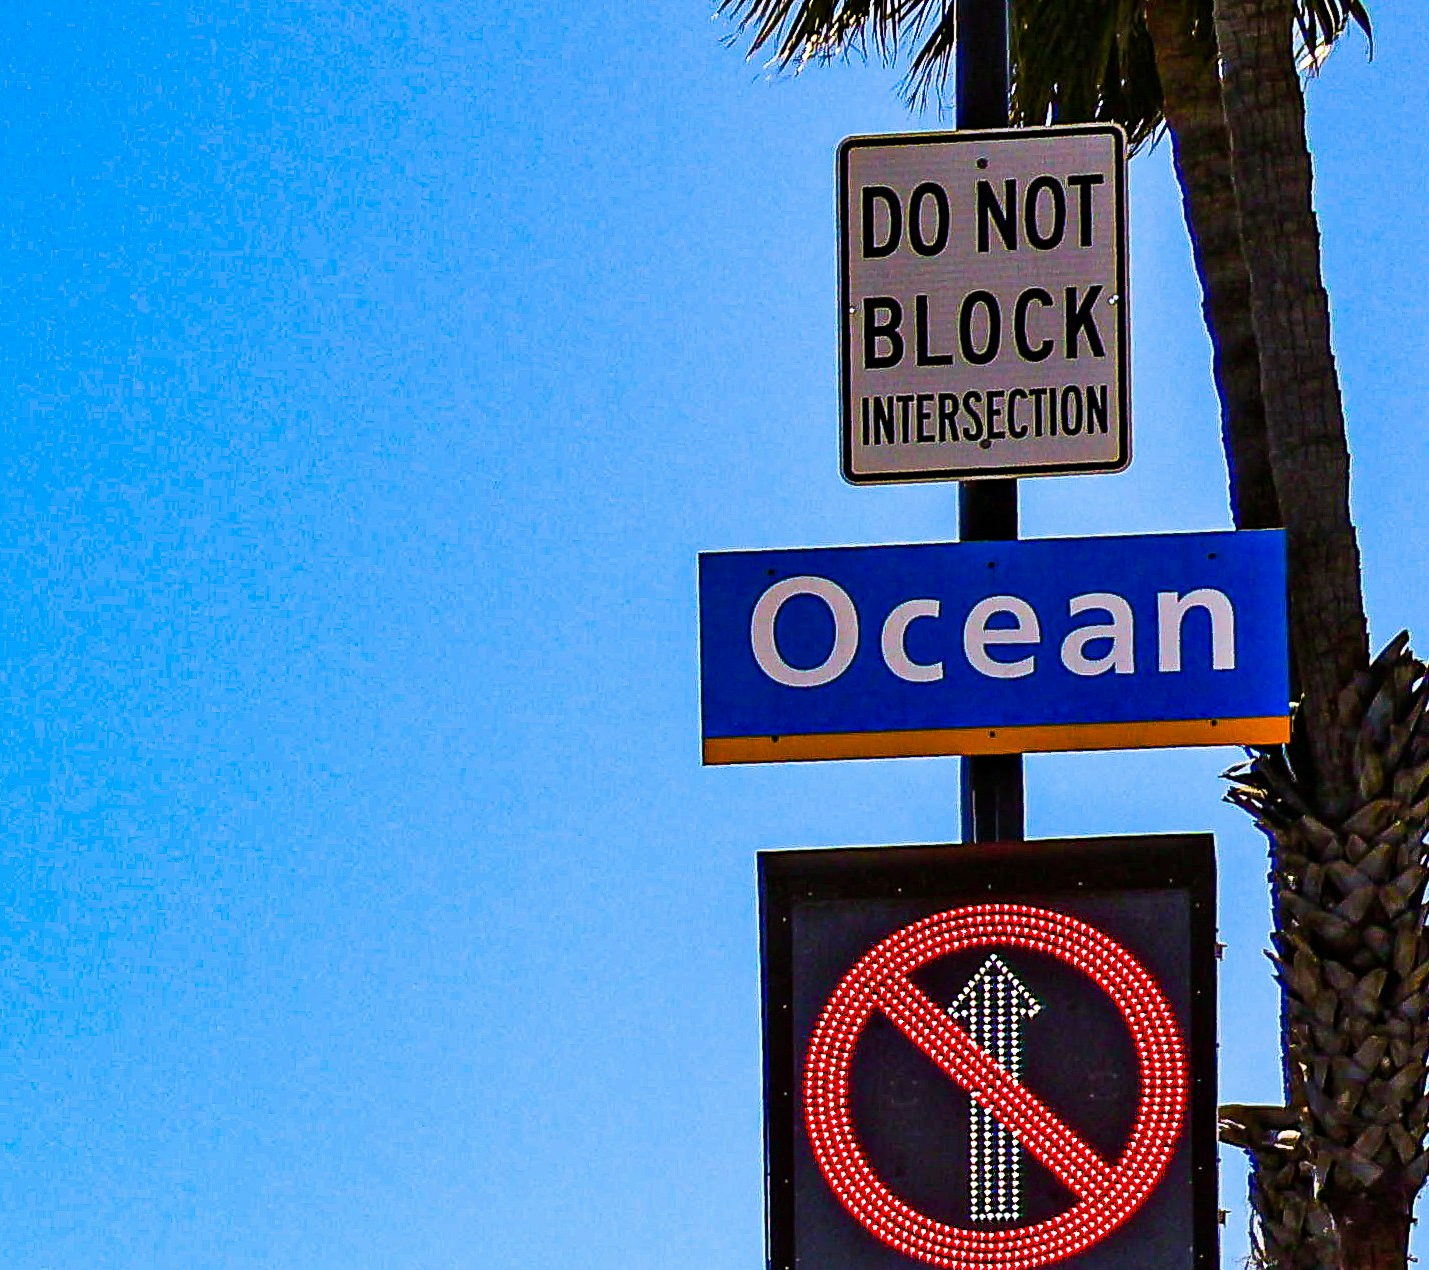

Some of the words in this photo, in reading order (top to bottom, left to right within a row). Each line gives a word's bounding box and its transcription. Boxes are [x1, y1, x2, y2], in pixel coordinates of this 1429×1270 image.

[861, 181, 951, 259] DO
[976, 172, 1104, 254] NOT
[862, 284, 1106, 370] BLOCK
[861, 385, 1109, 446] INTERSECTION
[750, 575, 1236, 689] Ocean
